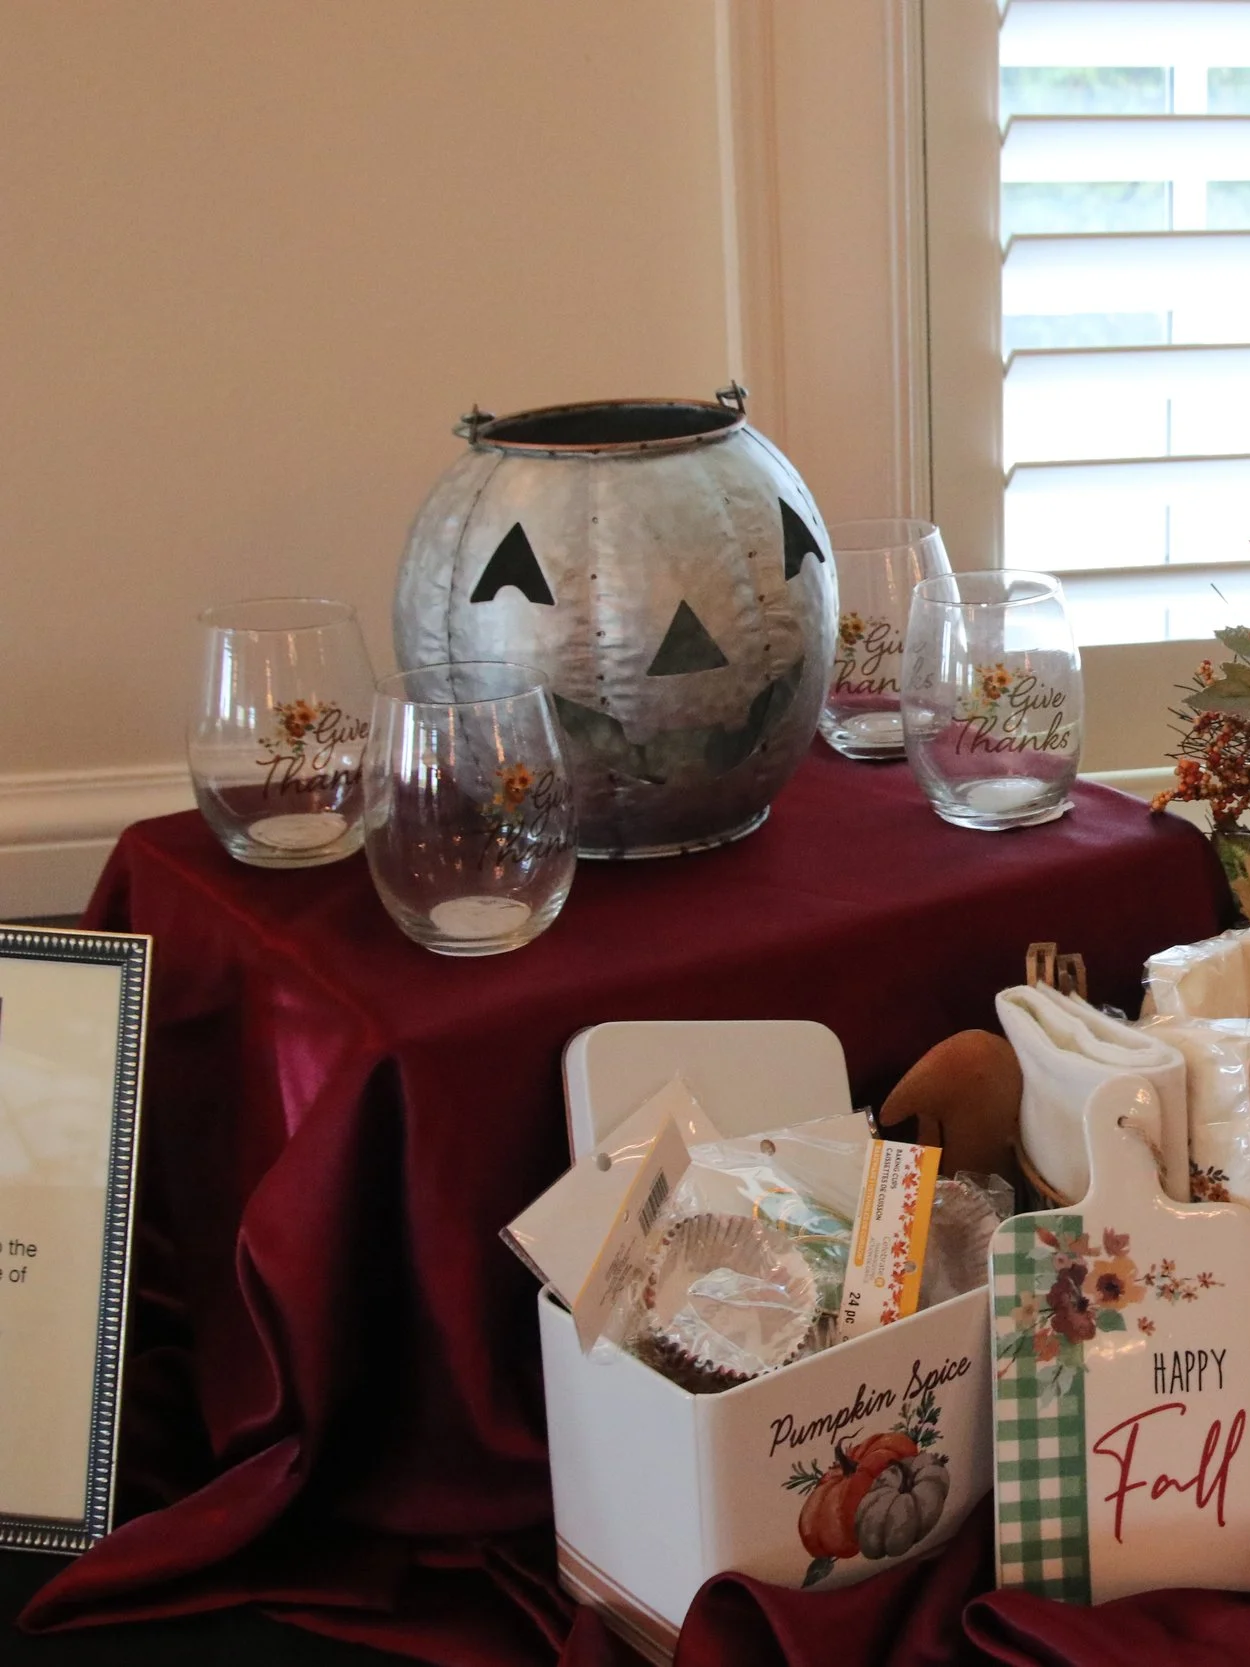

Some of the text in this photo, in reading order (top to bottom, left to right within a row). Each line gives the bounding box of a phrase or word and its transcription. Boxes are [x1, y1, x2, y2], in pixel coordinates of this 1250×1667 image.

[1003, 676, 1066, 732] Give
[312, 708, 369, 770] Give
[952, 711, 1071, 755] Thanks
[875, 1147, 893, 1222] CAISSETTES DE CUISSON
[890, 1148, 904, 1190] BAKING CUPS
[9, 1238, 37, 1258] the
[9, 1266, 28, 1283] of
[845, 1309, 856, 1325] pc
[848, 1292, 861, 1307] 24
[1153, 1348, 1227, 1395] HAPPY
[769, 1356, 972, 1458] Pumpkin Spice
[1093, 1402, 1246, 1544] Fall
